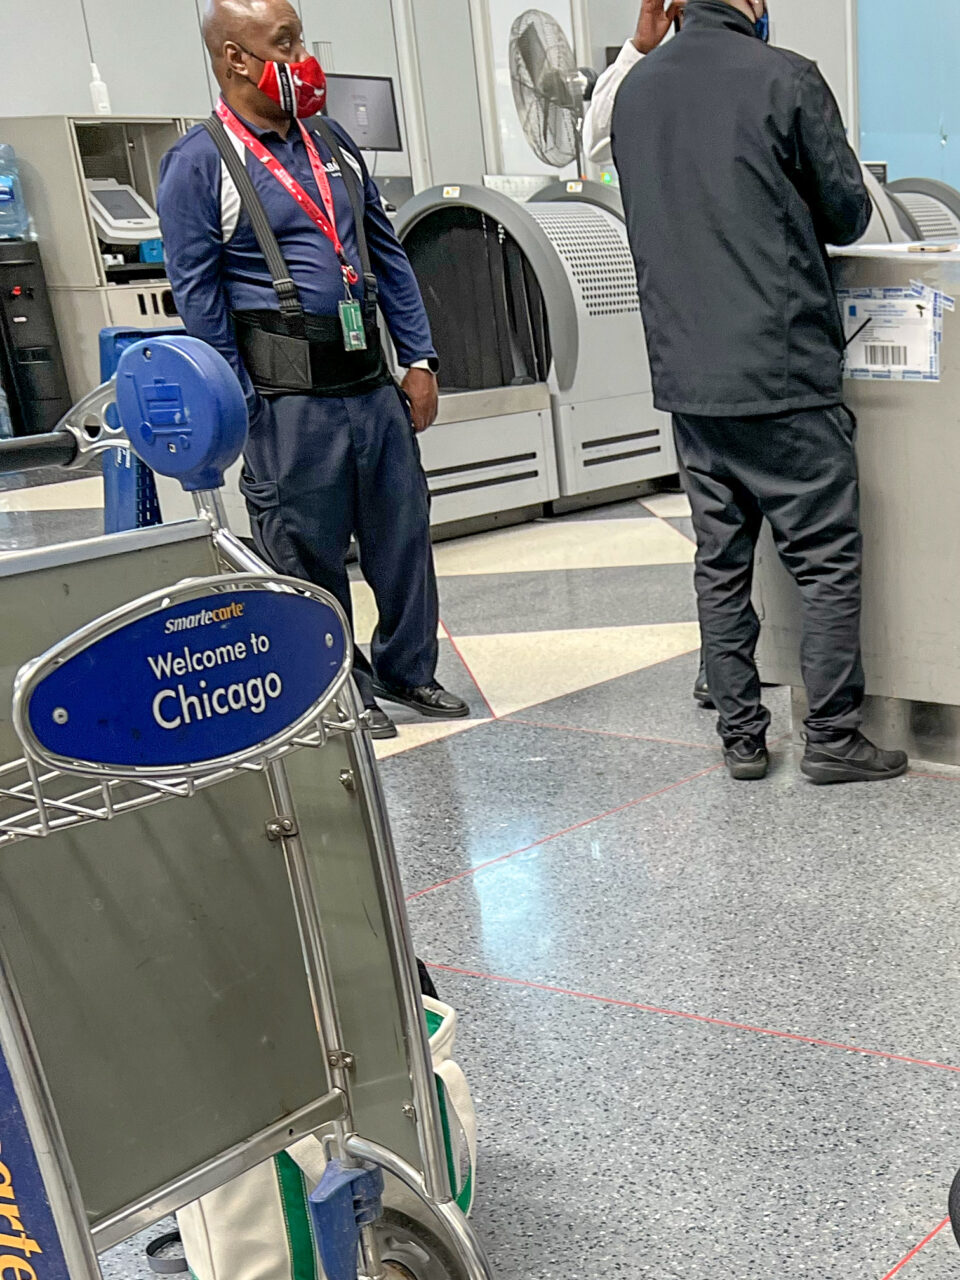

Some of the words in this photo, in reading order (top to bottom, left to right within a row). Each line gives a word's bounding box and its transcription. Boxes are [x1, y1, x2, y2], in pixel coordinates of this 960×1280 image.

[164, 602, 245, 634] smartecarte
[147, 642, 247, 680] Welcome
[250, 633, 270, 654] to
[152, 672, 282, 729] Chicago
